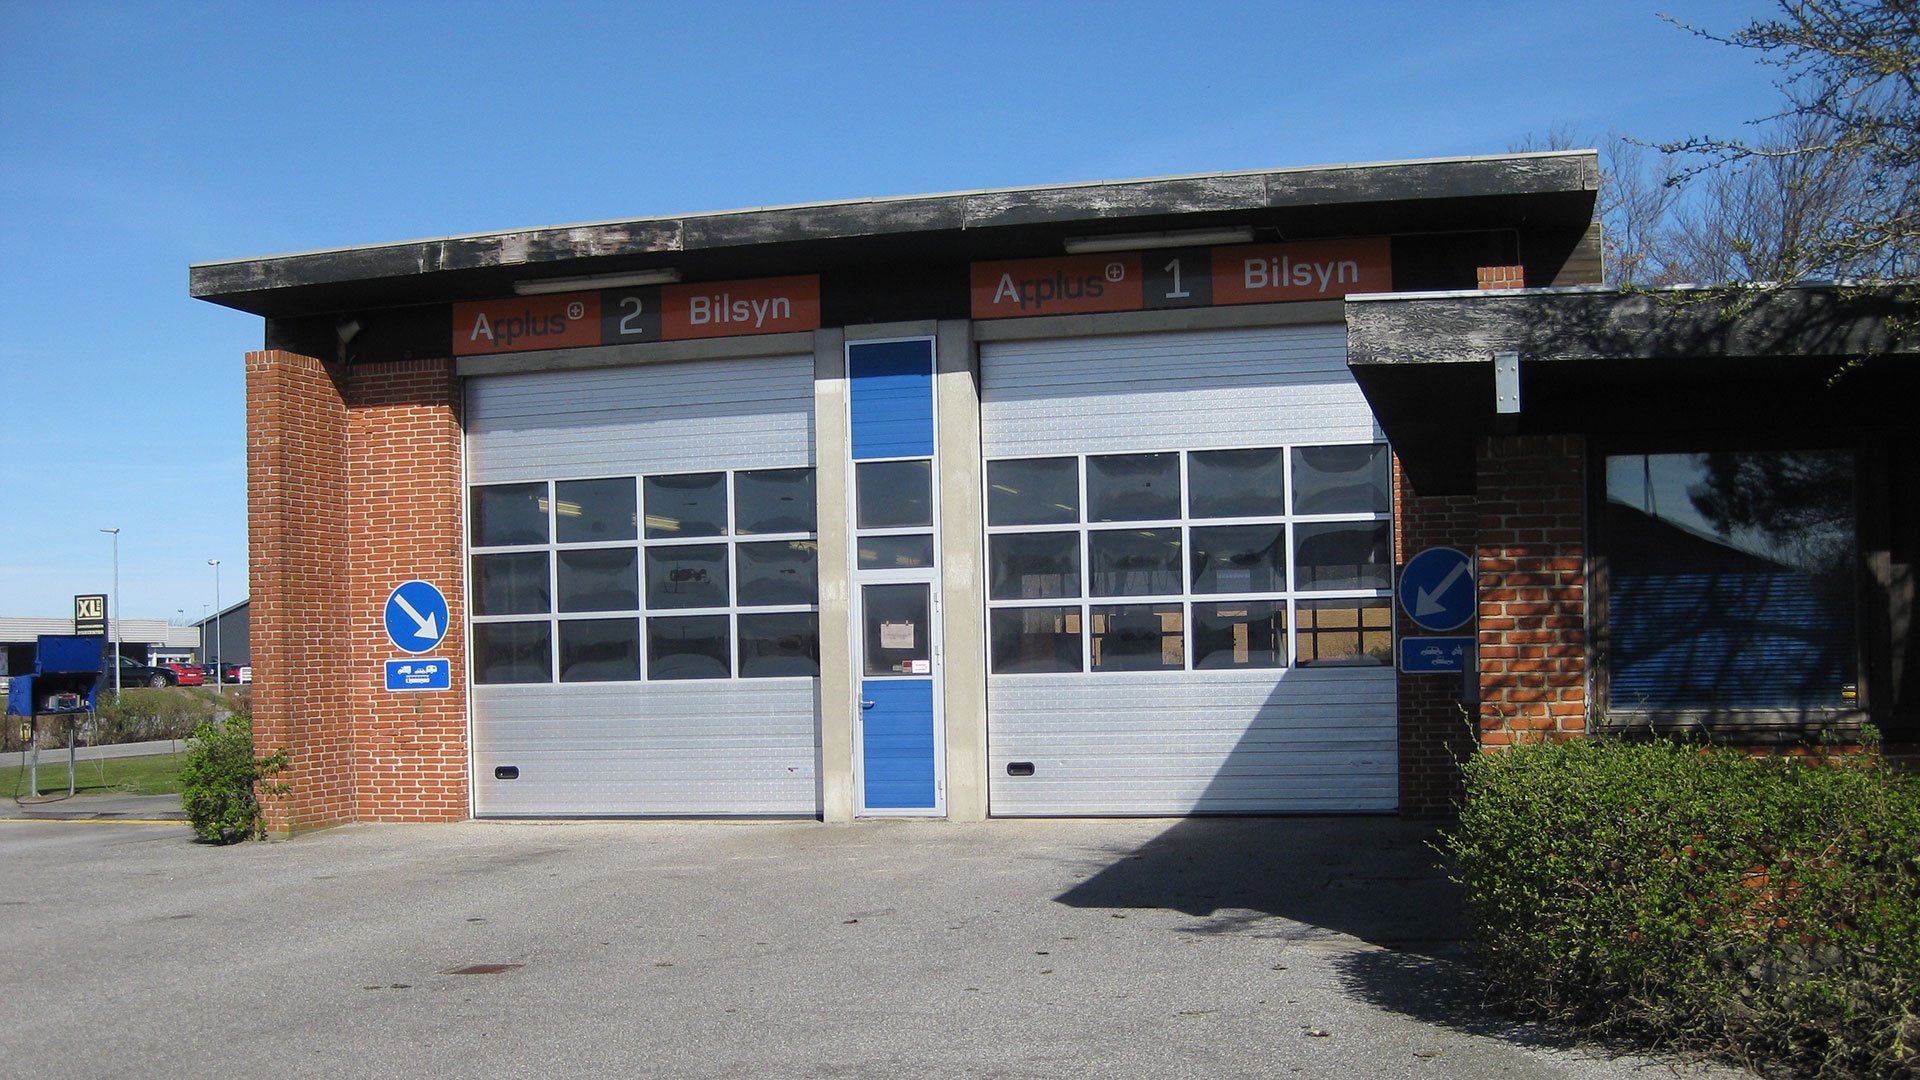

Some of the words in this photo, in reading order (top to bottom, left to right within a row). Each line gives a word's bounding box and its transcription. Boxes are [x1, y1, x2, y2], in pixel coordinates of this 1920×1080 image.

[1164, 258, 1190, 299] 1
[1244, 255, 1359, 293] Bilsyn
[619, 296, 643, 335] 2
[690, 293, 791, 328] Bilsyn
[78, 600, 101, 617] XL
